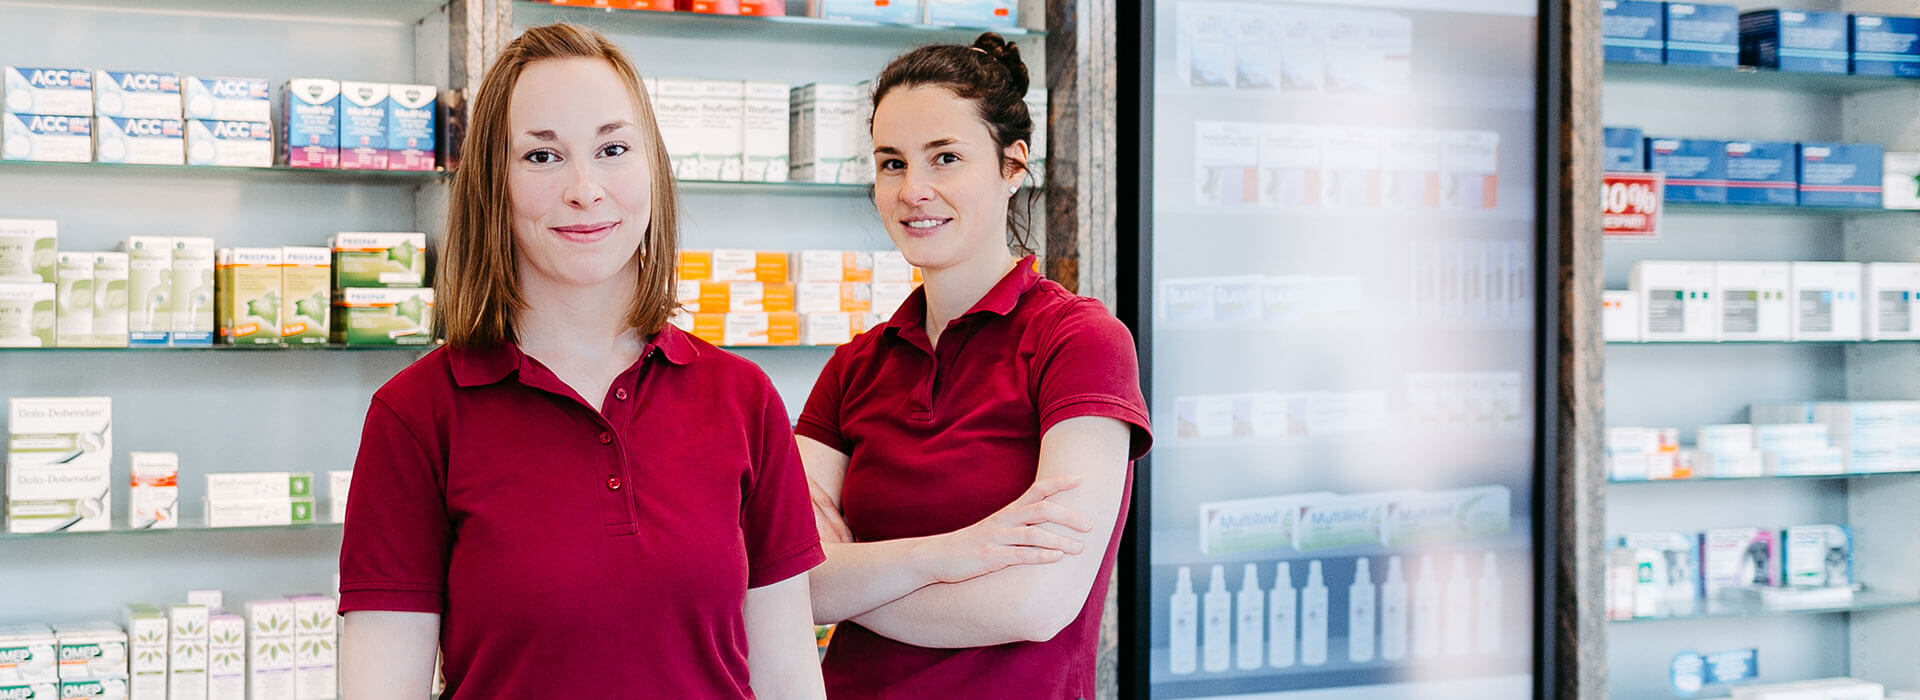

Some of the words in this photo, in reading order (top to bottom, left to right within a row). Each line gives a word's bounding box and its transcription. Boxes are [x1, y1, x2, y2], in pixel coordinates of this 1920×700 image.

[31, 70, 70, 86] ACC
[121, 73, 159, 90] ACC
[213, 80, 248, 97] ACC
[30, 116, 69, 132] ACC
[124, 118, 162, 135] ACC
[214, 121, 250, 138] ACC
[0, 648, 31, 663] MEP
[62, 645, 100, 660] OMEP
[0, 685, 33, 700] MEP
[63, 683, 102, 698] OMEP
